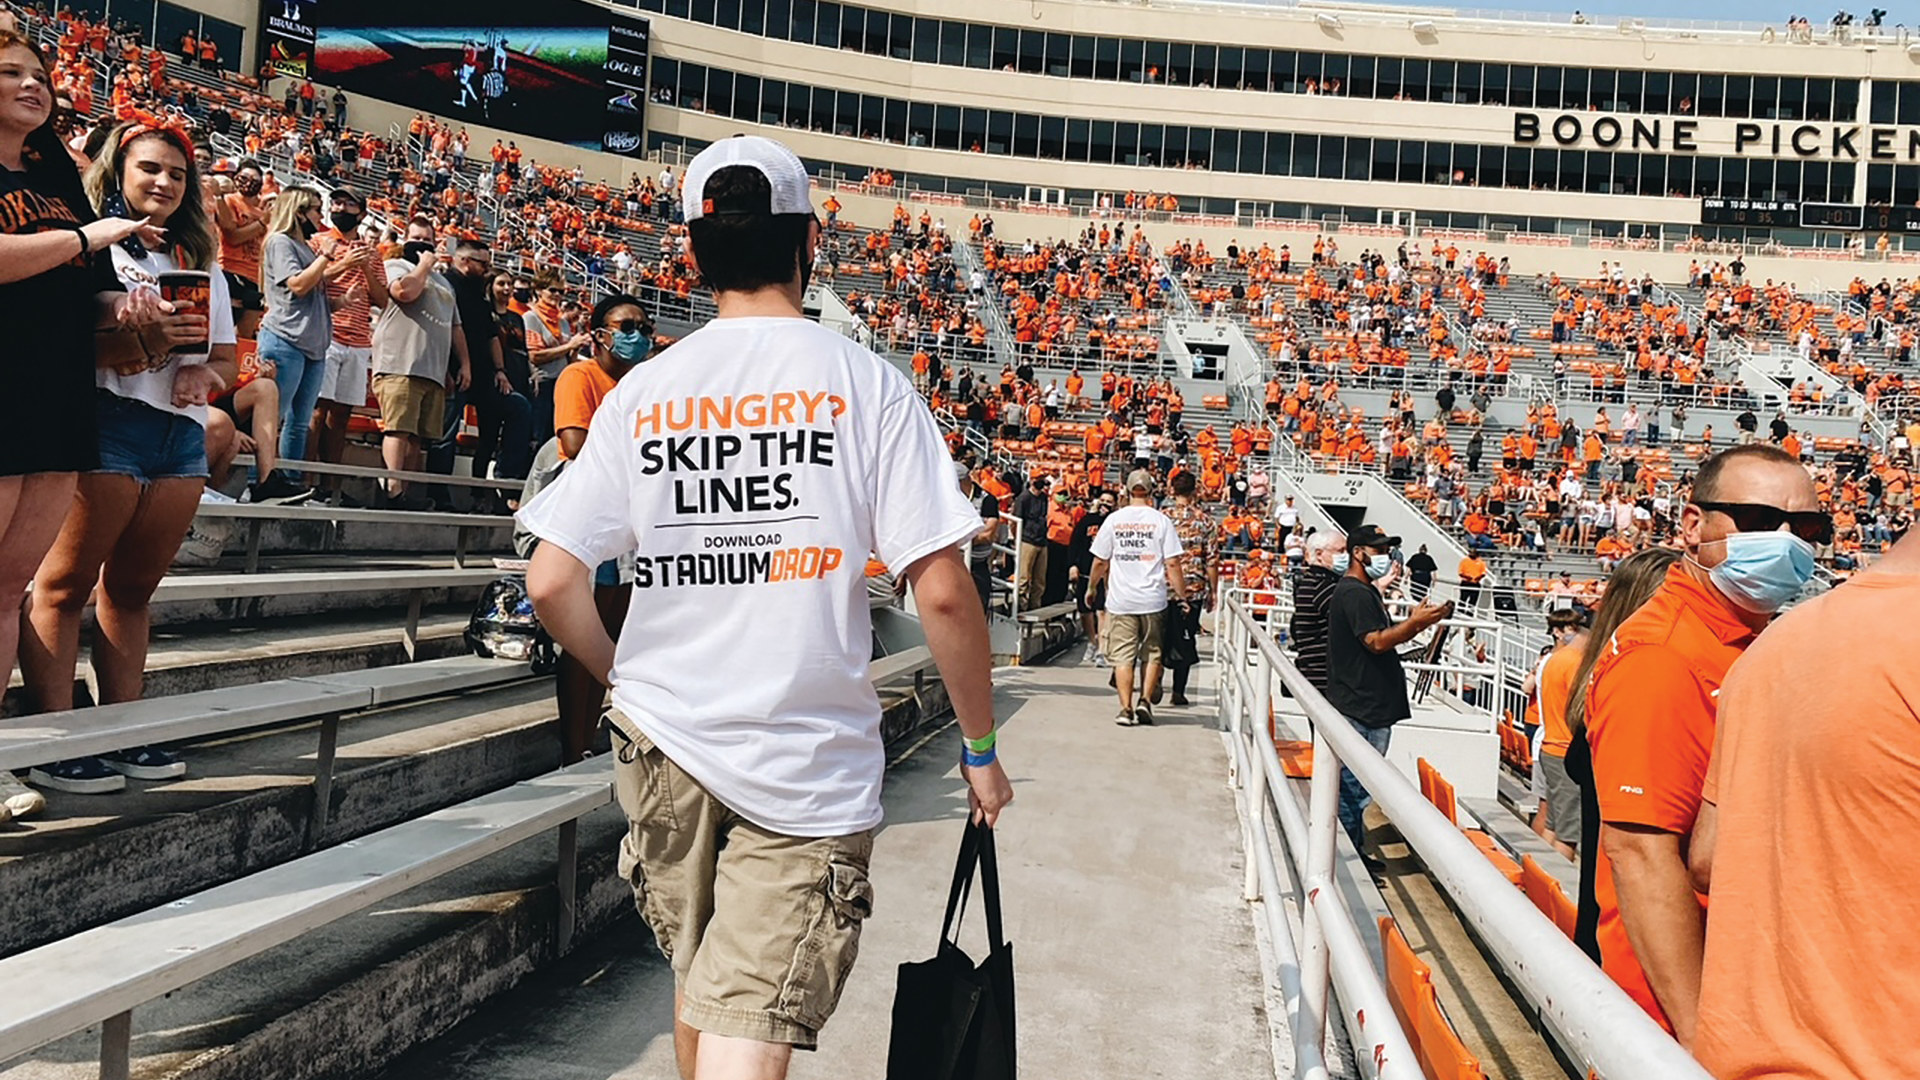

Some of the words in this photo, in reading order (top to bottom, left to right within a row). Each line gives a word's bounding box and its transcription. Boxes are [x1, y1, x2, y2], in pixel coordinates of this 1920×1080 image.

[611, 25, 646, 40] NISSAN
[1514, 112, 1698, 150] BOONE
[633, 390, 847, 439] HUNGRY?
[640, 435, 742, 475] SKIP
[750, 429, 834, 467] THE
[674, 473, 799, 514] LINES.
[704, 533, 782, 548] DOWNLOAD
[1115, 531, 1135, 539] SKIP
[1137, 531, 1154, 539] THE
[635, 546, 843, 588] STADIUMDROP
[1620, 785, 1644, 795] PING
